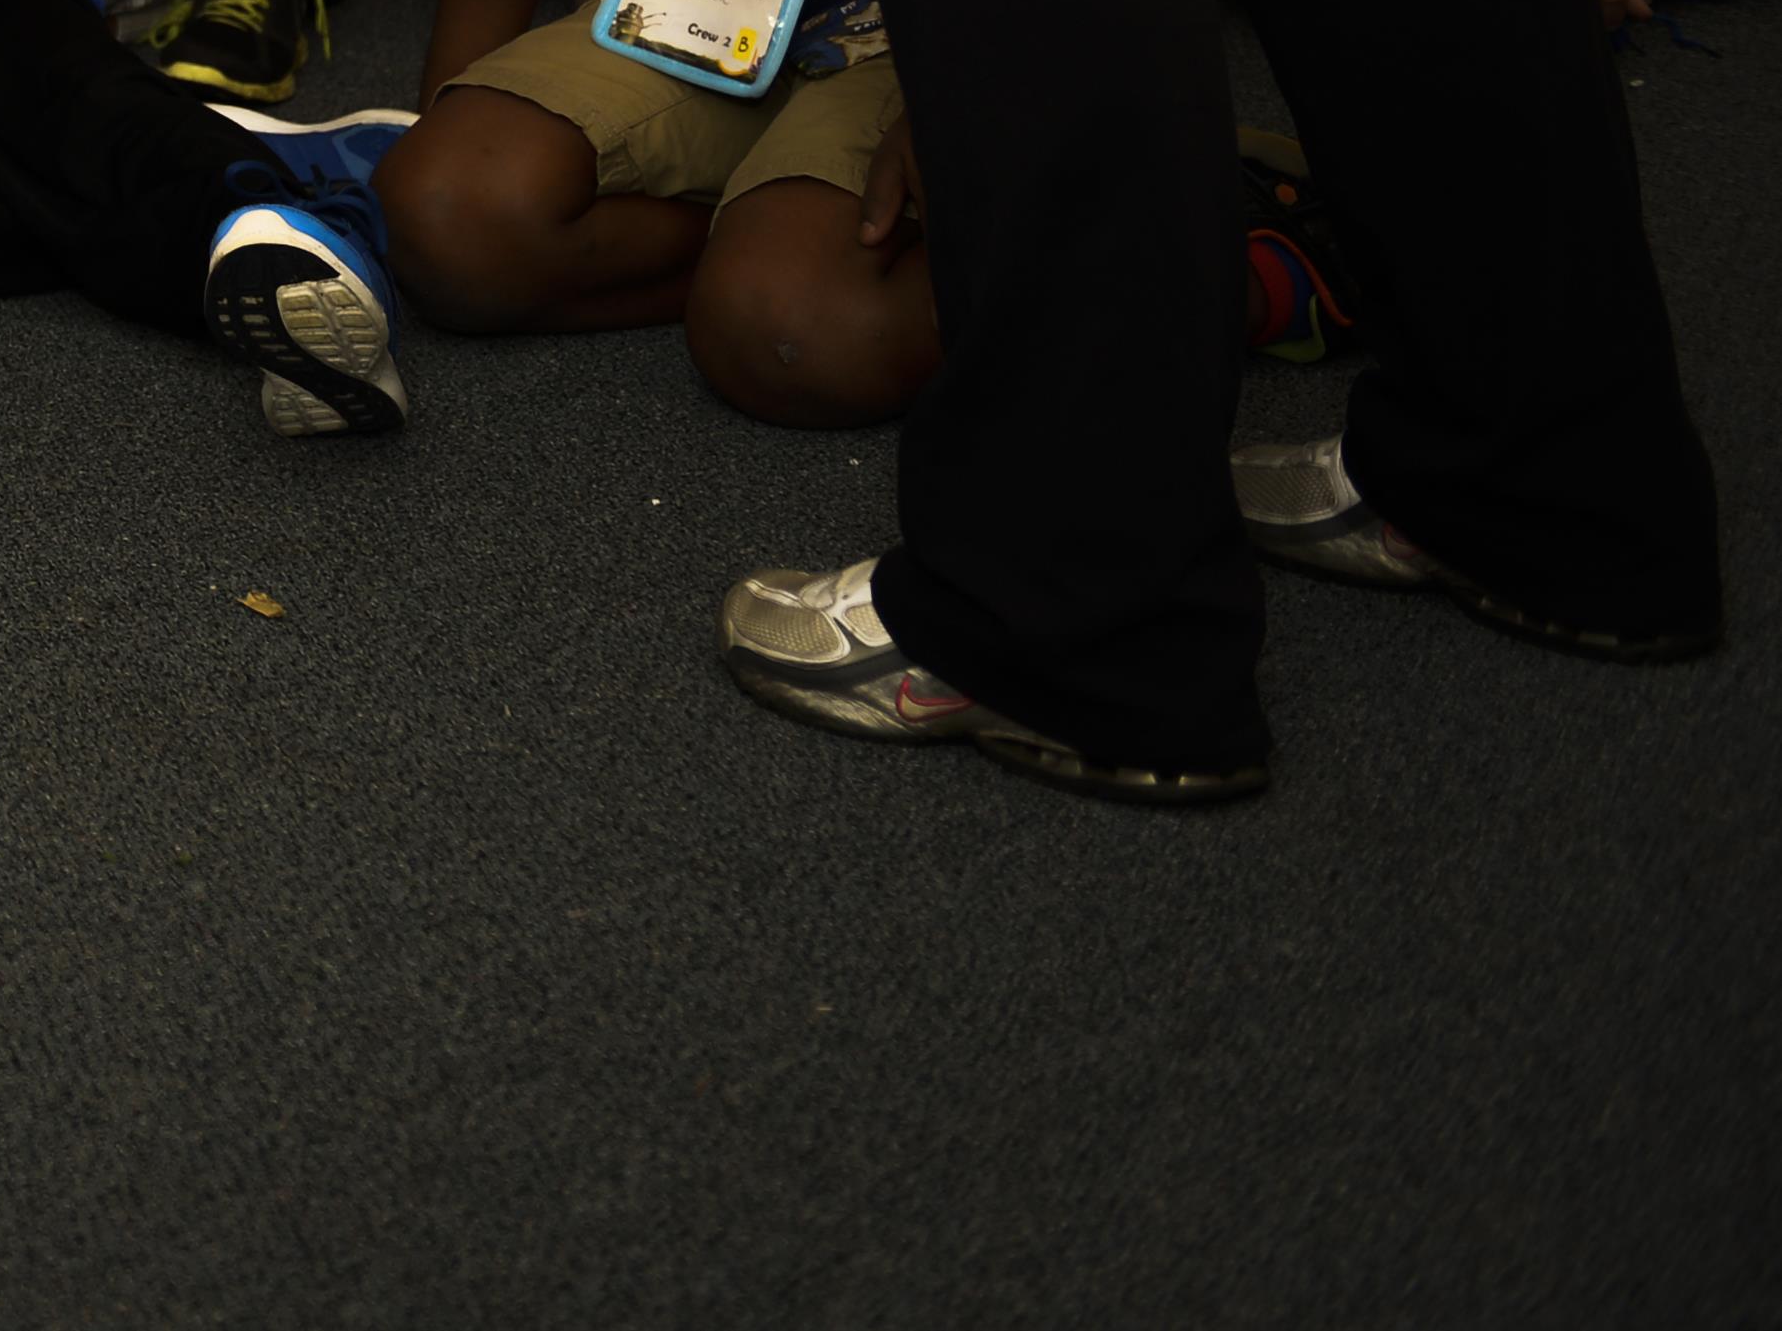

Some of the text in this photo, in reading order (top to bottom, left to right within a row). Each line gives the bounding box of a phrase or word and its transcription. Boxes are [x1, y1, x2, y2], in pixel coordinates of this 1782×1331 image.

[687, 23, 732, 48] Crew 2
[738, 35, 750, 53] B
